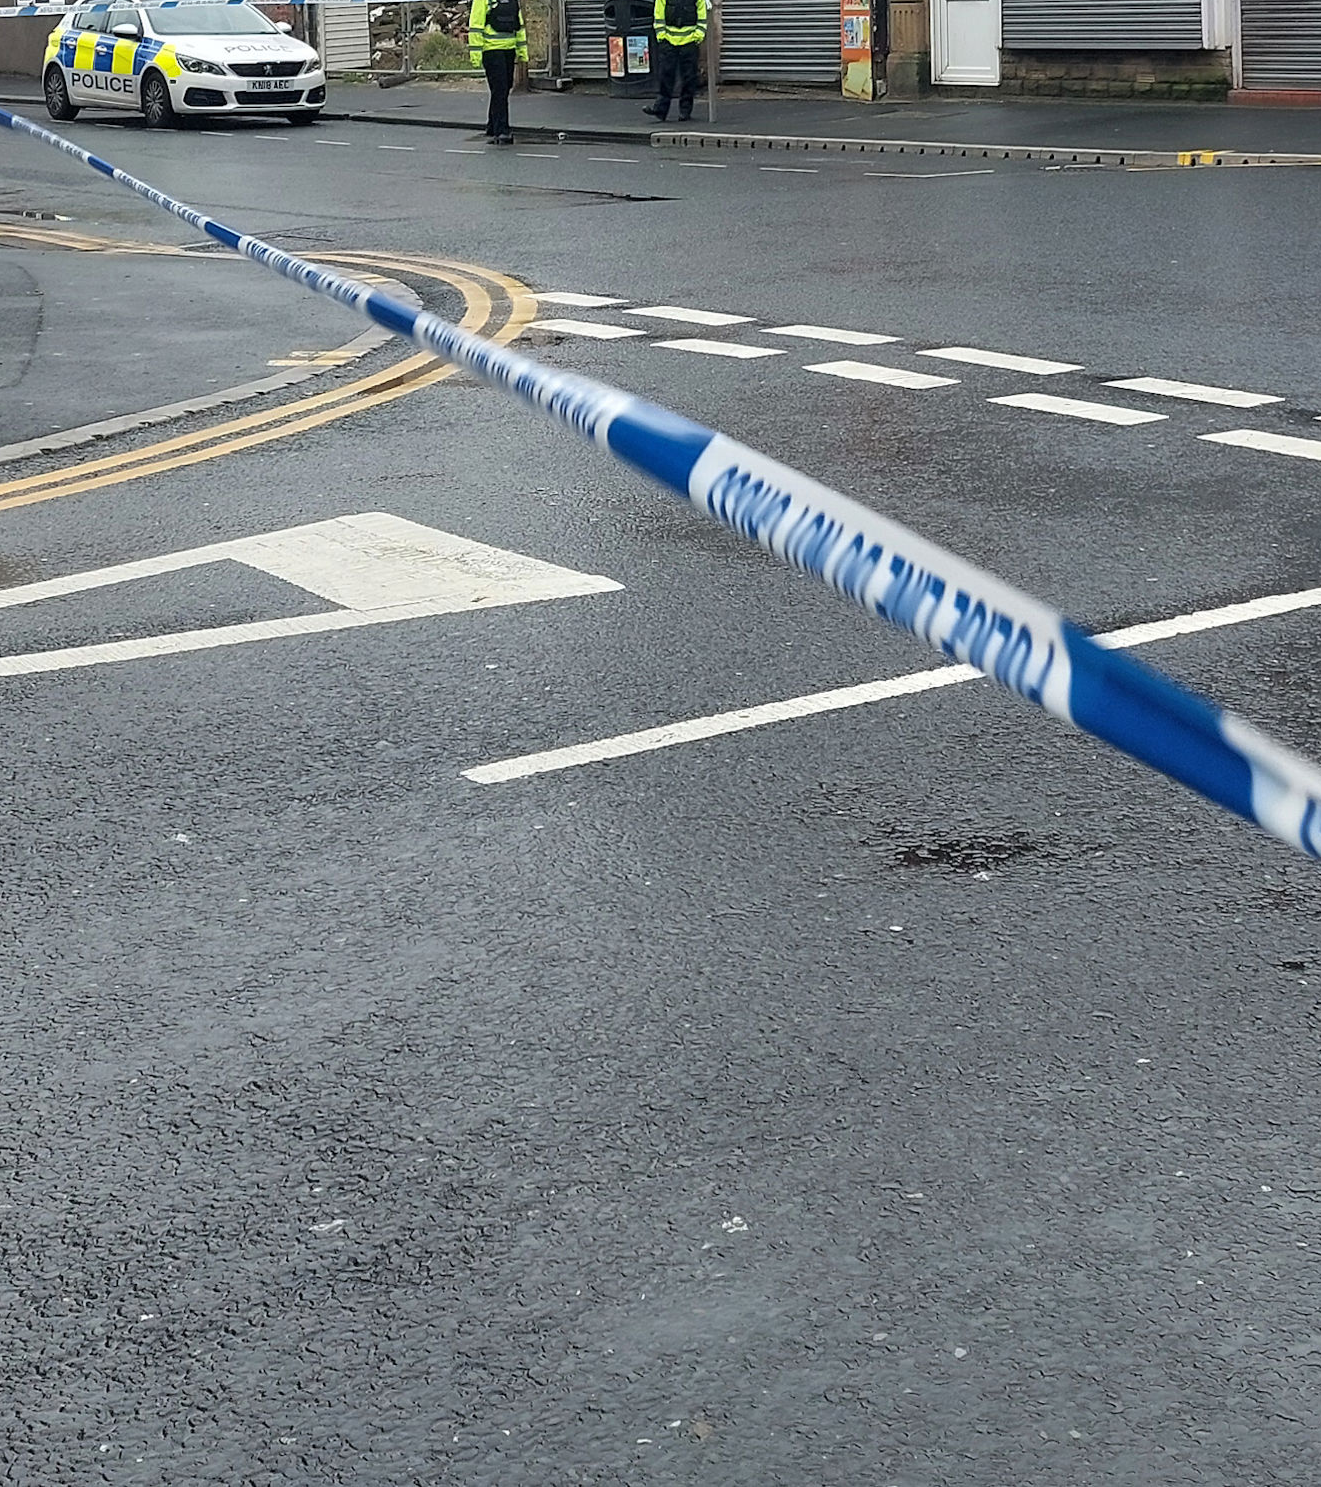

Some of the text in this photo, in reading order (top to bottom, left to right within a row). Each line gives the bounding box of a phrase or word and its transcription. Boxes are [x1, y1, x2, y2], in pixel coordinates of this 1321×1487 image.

[224, 45, 294, 54] POLICE
[71, 72, 134, 94] POLICE
[274, 80, 290, 89] AEC
